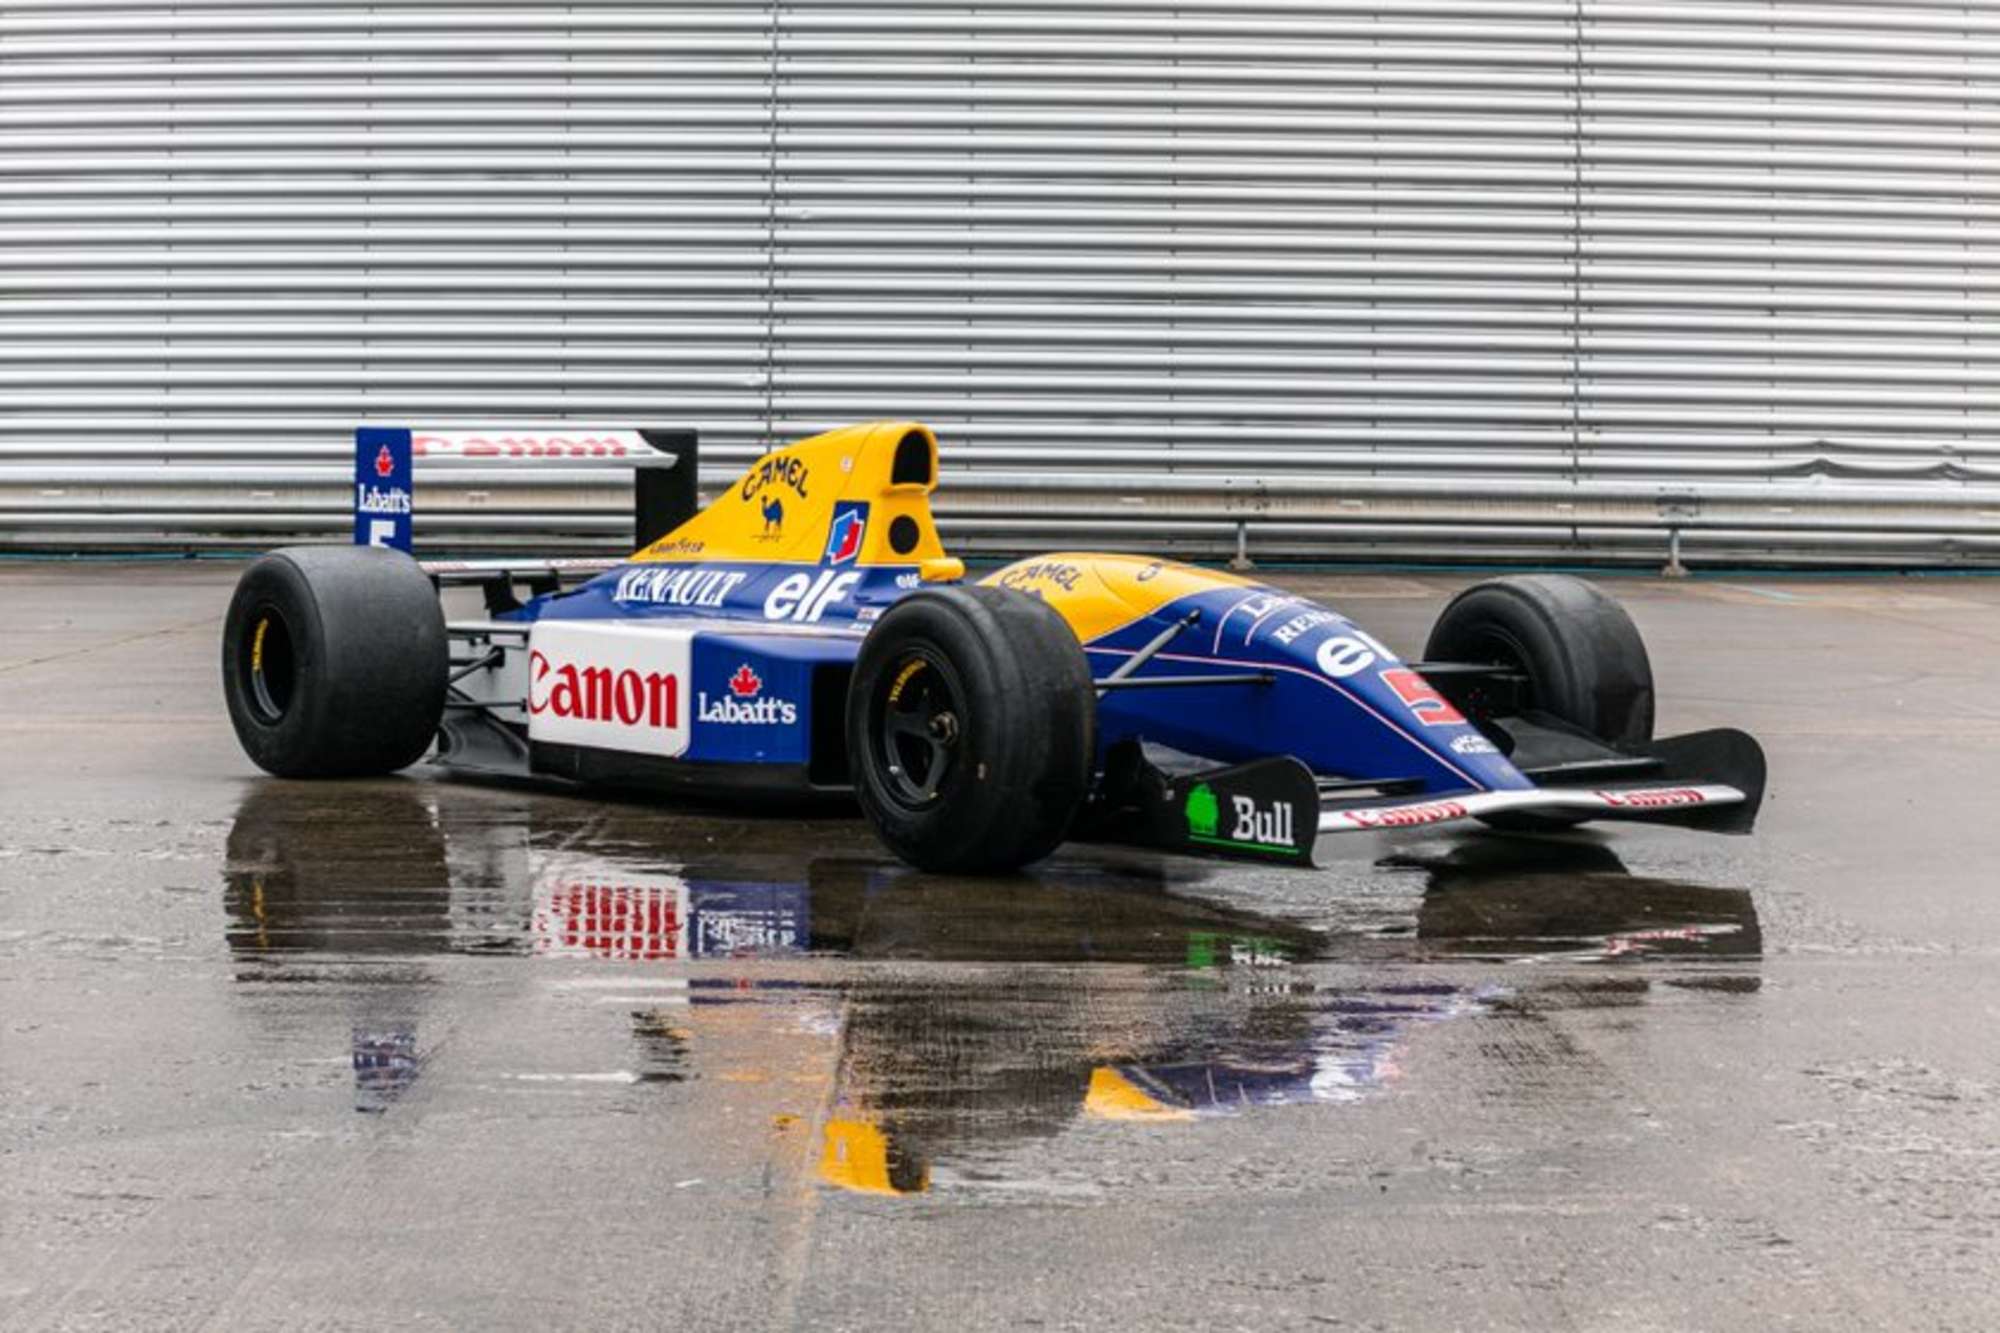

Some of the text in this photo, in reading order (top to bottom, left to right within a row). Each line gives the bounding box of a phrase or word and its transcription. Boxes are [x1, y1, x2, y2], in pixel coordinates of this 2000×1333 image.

[358, 483, 411, 514] Labatt's
[742, 456, 808, 501] CAMEL
[613, 568, 746, 608] RENAULT
[763, 569, 862, 622] elf
[1000, 562, 1082, 592] CAMEL
[529, 650, 678, 730] Canon
[698, 691, 798, 725] Labatt's
[1377, 668, 1468, 727] 5
[1231, 794, 1296, 847] Bull
